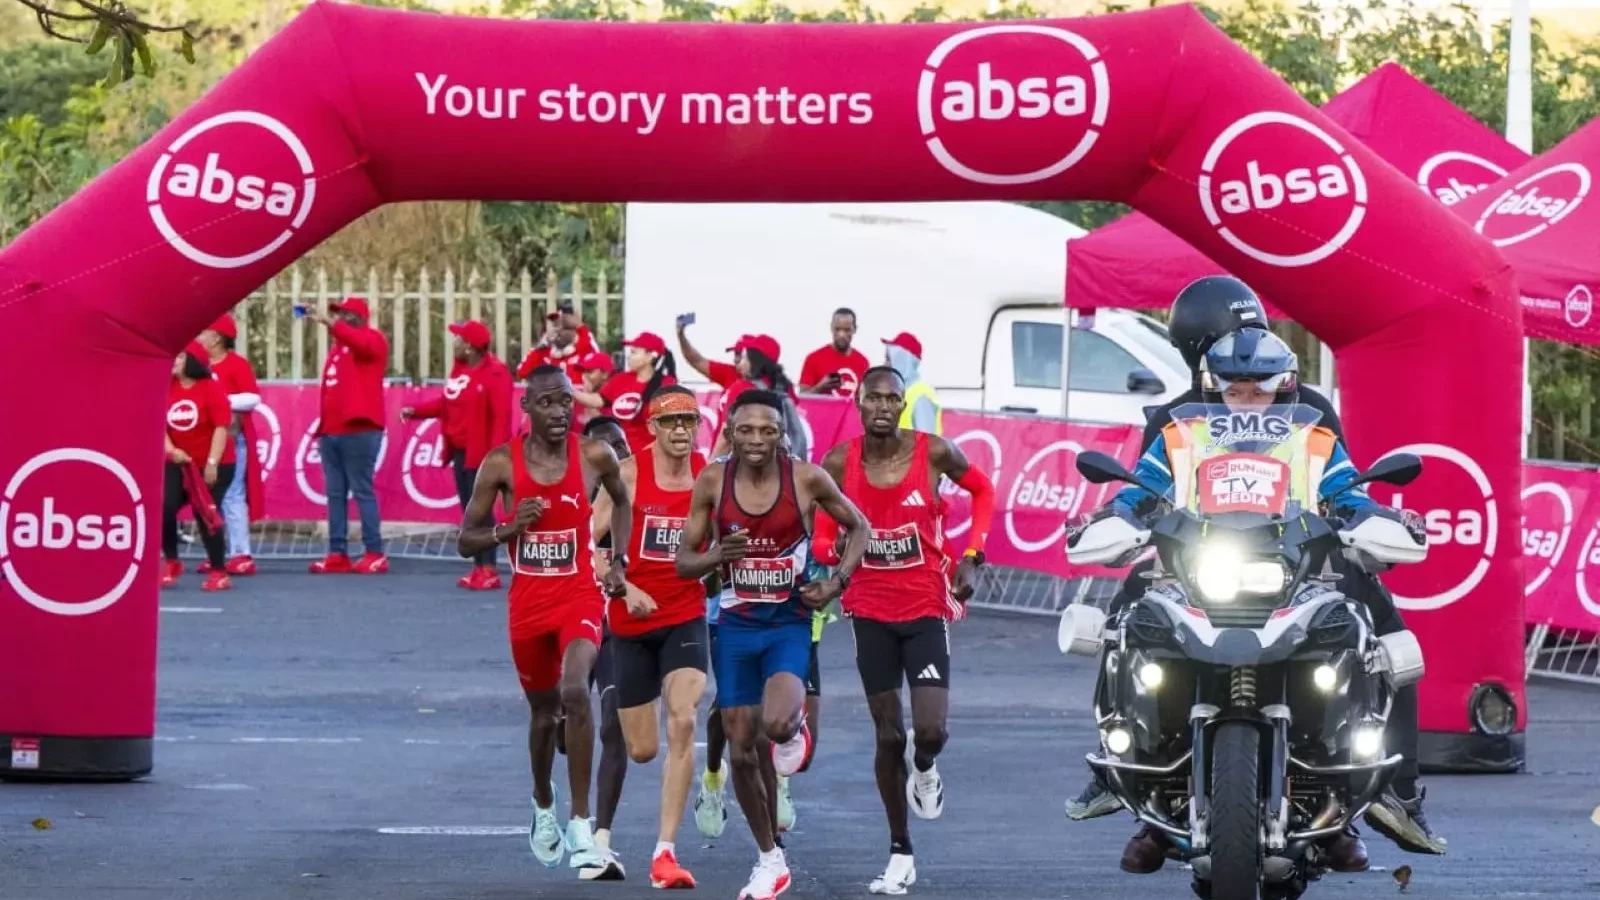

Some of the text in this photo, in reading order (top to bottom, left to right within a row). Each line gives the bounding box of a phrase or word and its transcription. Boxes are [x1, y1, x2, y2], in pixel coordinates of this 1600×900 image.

[415, 72, 873, 135] Your story matters
[940, 62, 1087, 122] absa
[167, 153, 297, 217] absa
[1219, 160, 1349, 214] absa
[1495, 187, 1568, 218] absa
[1209, 412, 1291, 438] SMG
[1017, 472, 1075, 511] absa
[1216, 491, 1269, 508] MEDIA
[1221, 476, 1258, 492] TV
[12, 497, 132, 550] absa
[524, 542, 569, 560] KABELO
[734, 567, 792, 586] KAMOHELO
